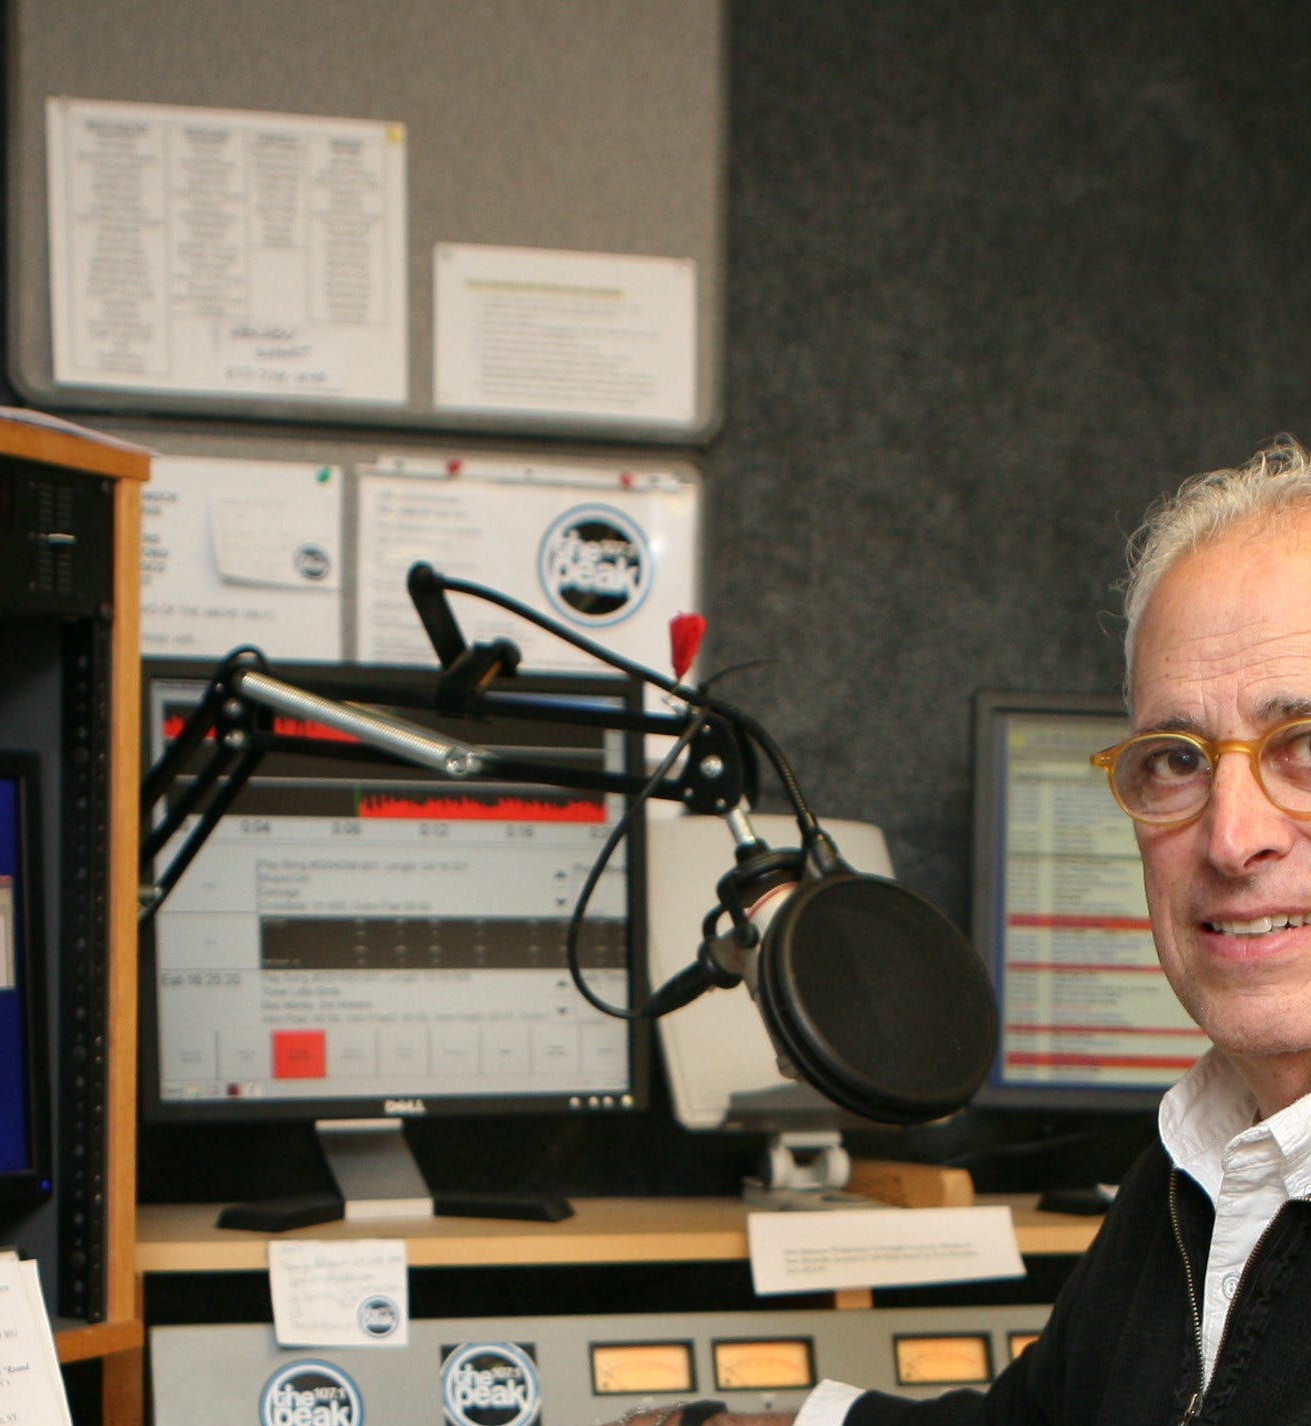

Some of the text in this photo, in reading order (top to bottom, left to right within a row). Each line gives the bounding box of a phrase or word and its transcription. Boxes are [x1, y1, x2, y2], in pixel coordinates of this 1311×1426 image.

[453, 1362, 491, 1388] the
[272, 1382, 315, 1410] the
[454, 1378, 530, 1409] peak
